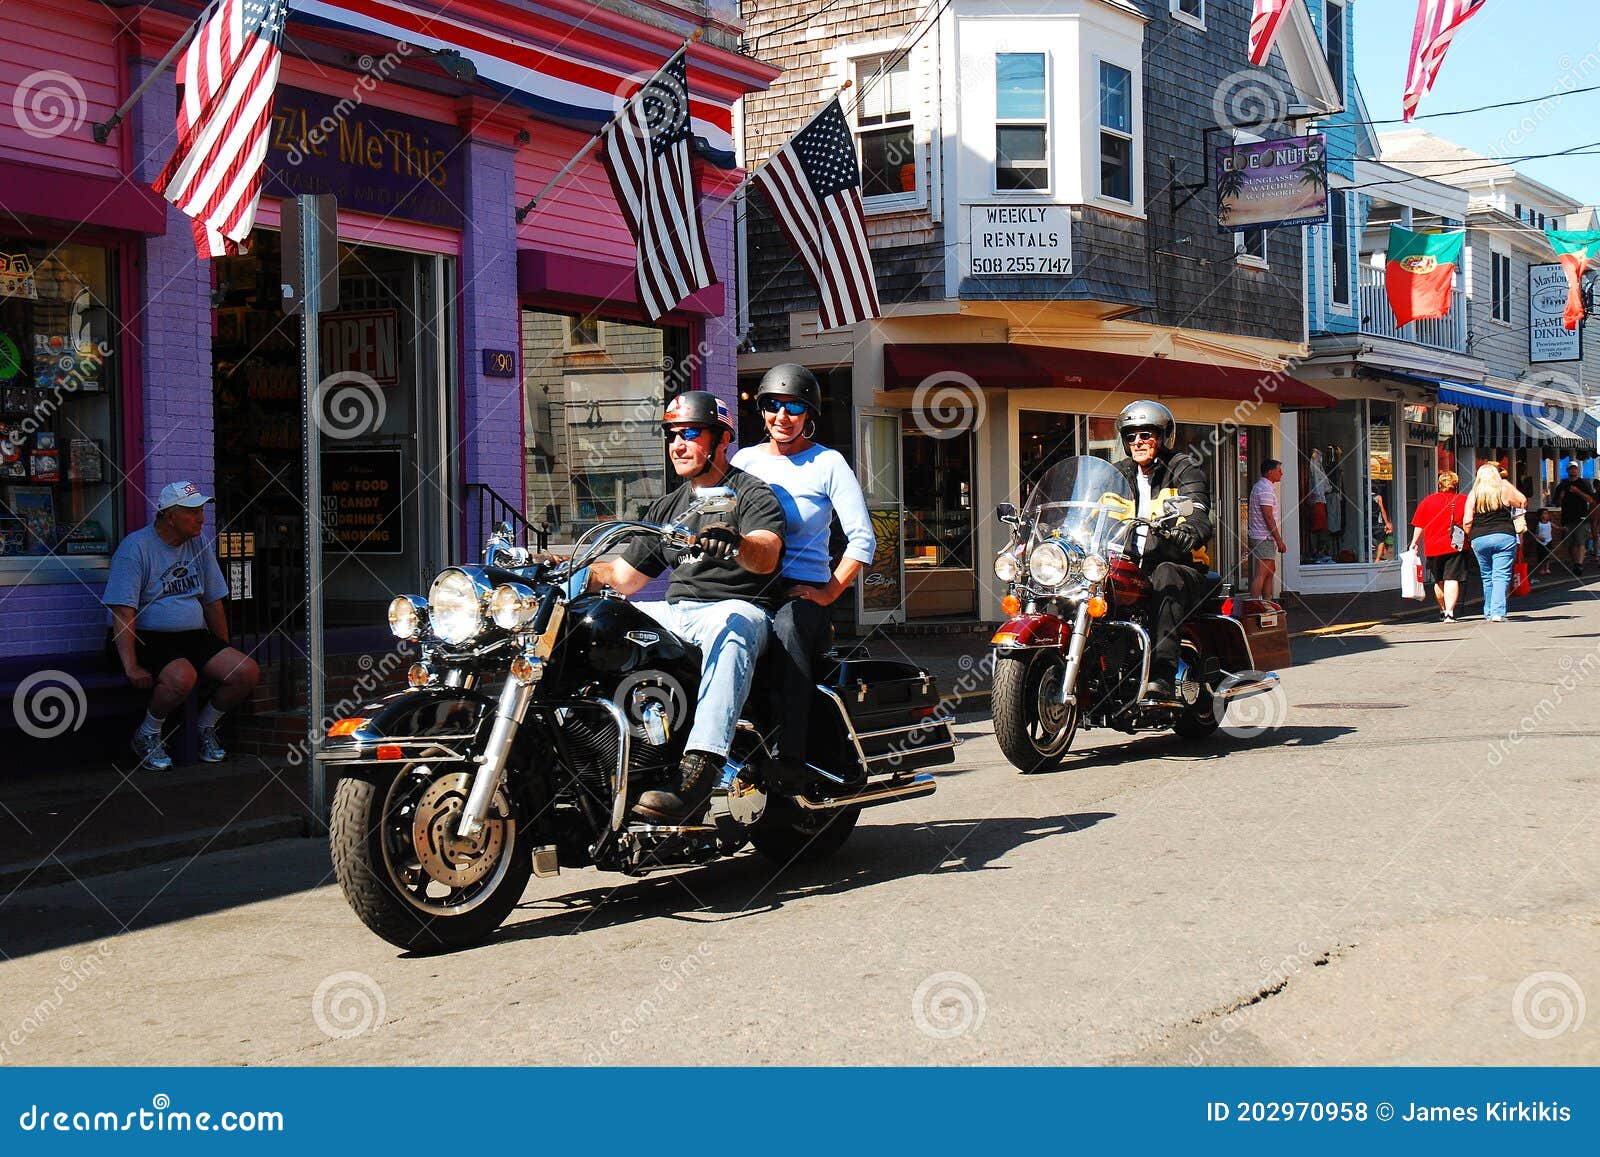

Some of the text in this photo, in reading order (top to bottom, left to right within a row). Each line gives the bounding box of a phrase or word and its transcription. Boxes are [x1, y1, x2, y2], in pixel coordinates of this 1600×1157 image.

[339, 118, 384, 169] Me
[383, 127, 448, 188] This
[1244, 174, 1300, 186] SUNGLASSES
[1250, 182, 1293, 193] WATCHES
[1245, 190, 1302, 201] ACCESSORIES
[987, 208, 1046, 223] WEEKLY
[983, 232, 1058, 248] RENTALS
[973, 257, 1071, 273] 508 255 7147
[1535, 317, 1563, 328] FAMI
[1534, 327, 1576, 340] DINING
[322, 316, 395, 378] OPEN
[490, 353, 513, 373] 290
[332, 480, 389, 492] NO FOOD
[321, 496, 379, 510] NO CANDY
[321, 512, 383, 526] NO DRINKS
[334, 530, 390, 541] SMOKING
